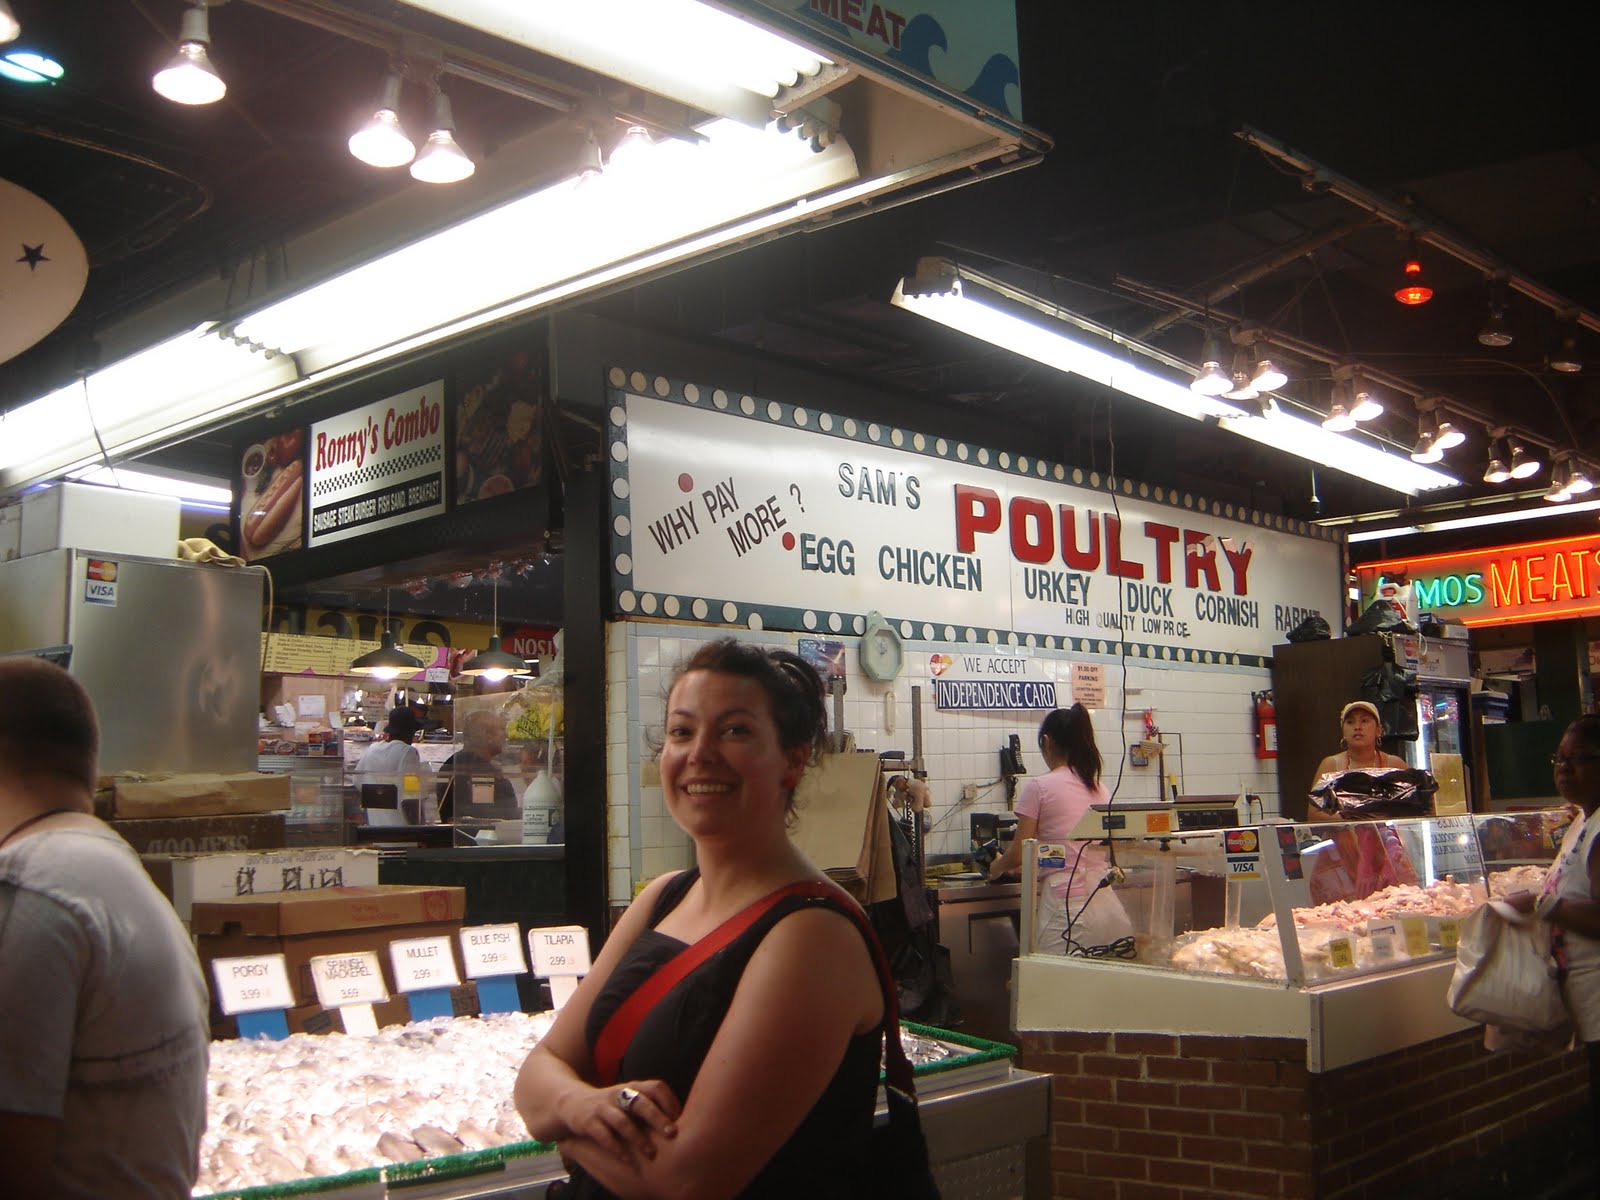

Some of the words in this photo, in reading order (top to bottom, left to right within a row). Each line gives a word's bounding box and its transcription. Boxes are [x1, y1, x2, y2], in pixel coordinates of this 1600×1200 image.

[315, 415, 379, 472] Ronny's
[383, 395, 441, 451] Combo
[838, 462, 921, 510] SAM'S
[313, 509, 337, 532] SAUSAGE
[338, 504, 356, 526] STEAK
[408, 480, 440, 506] BREAKFAST
[648, 500, 700, 555] WHY
[702, 477, 741, 524] PAY
[727, 494, 787, 557] MORE
[789, 482, 805, 513] ?
[954, 483, 1255, 596] POULTRY
[800, 532, 856, 576] EGG
[878, 544, 982, 592] CHICKEN
[1127, 582, 1174, 618] DUCK
[1195, 591, 1259, 629] CORNISH
[90, 585, 114, 597] VISA
[1142, 617, 1161, 634] LOW
[964, 657, 982, 673] WE
[987, 658, 1026, 674] ACCEPT
[939, 682, 1023, 707] INDEPENDENCE
[1024, 683, 1056, 707] CARD
[1233, 862, 1254, 872] VISA
[471, 934, 490, 946] BLUE
[493, 932, 510, 943] FISH
[544, 934, 574, 946] TILAPIA
[407, 946, 438, 959] MULLET
[481, 953, 498, 964] 2.99
[326, 958, 365, 971] SPANISH
[549, 957, 566, 966] 2.99
[232, 964, 269, 978] PORGY
[413, 969, 431, 980] 2.99
